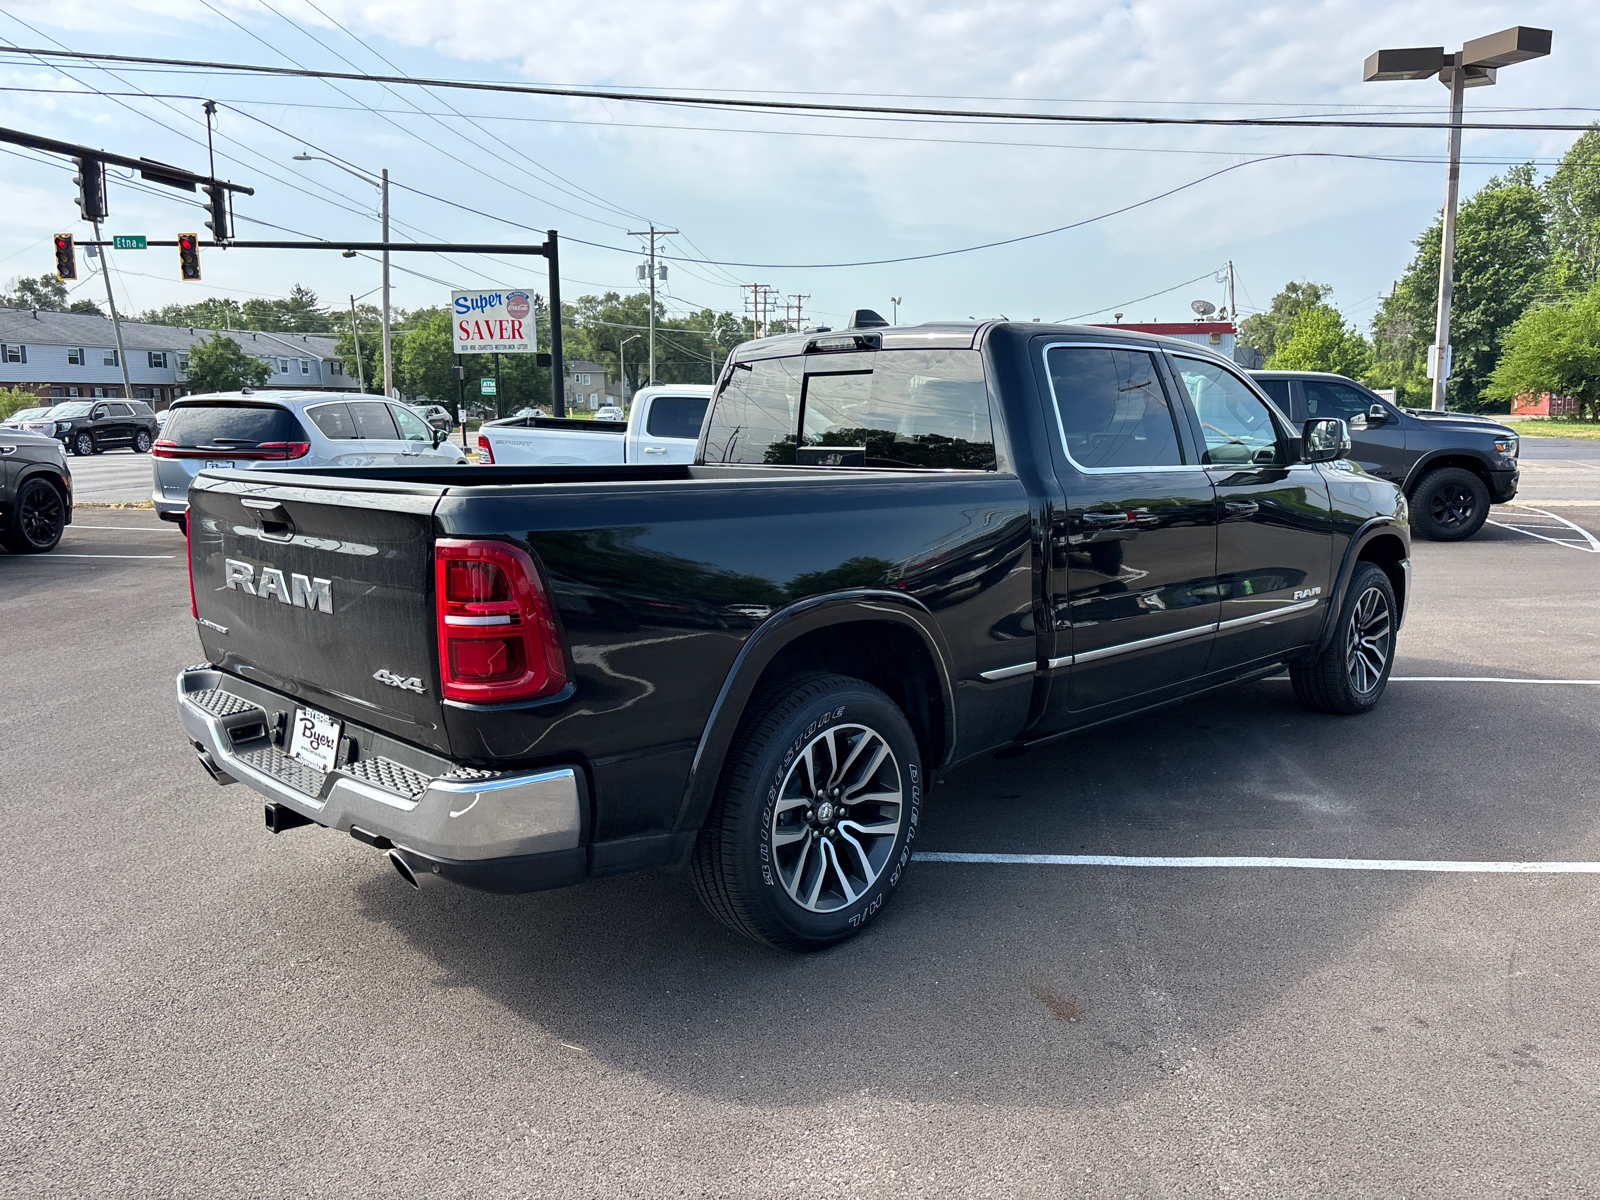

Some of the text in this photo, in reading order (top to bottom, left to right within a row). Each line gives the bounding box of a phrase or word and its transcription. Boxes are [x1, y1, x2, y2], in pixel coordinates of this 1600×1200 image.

[117, 237, 137, 248] Etna
[454, 292, 503, 315] Super
[459, 319, 524, 341] SAVER
[225, 558, 334, 615] RAM
[1293, 586, 1322, 600] RAM
[759, 705, 846, 887] BRIDGESTONE
[848, 763, 921, 927] DUELER H/L
